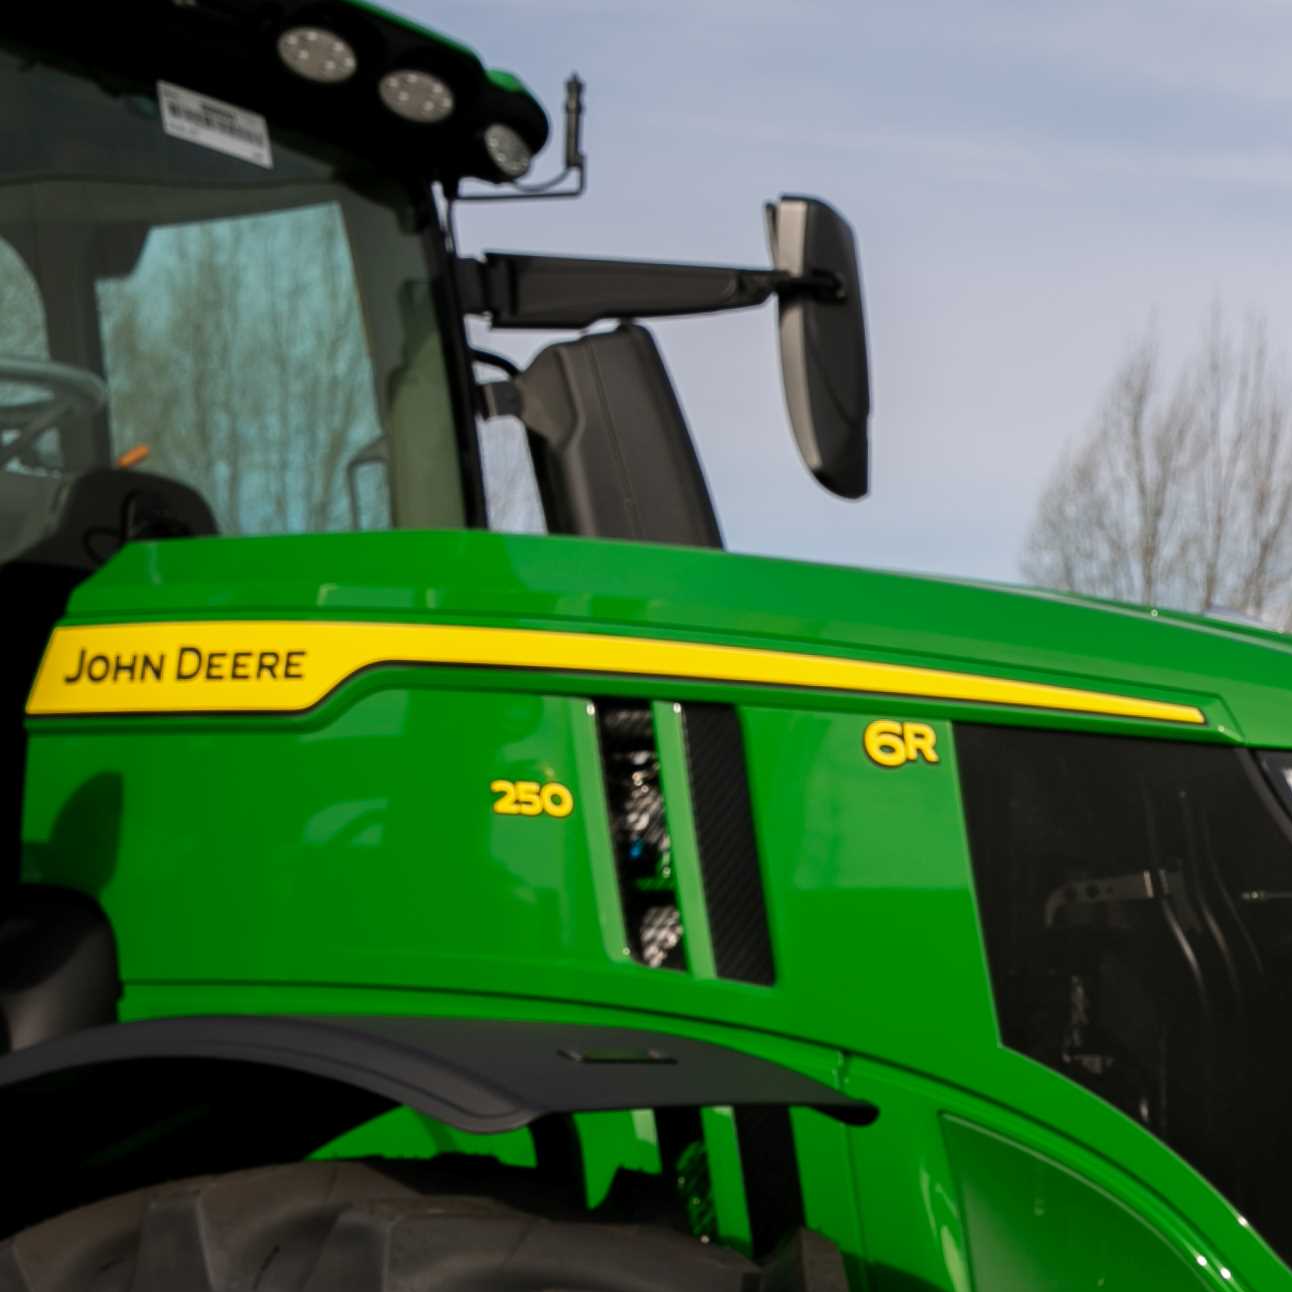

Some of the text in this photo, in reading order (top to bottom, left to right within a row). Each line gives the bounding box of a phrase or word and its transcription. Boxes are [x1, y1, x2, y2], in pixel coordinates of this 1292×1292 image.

[64, 646, 308, 684] JOHN DEERE
[863, 719, 940, 768] 6R
[490, 779, 574, 819] 250
